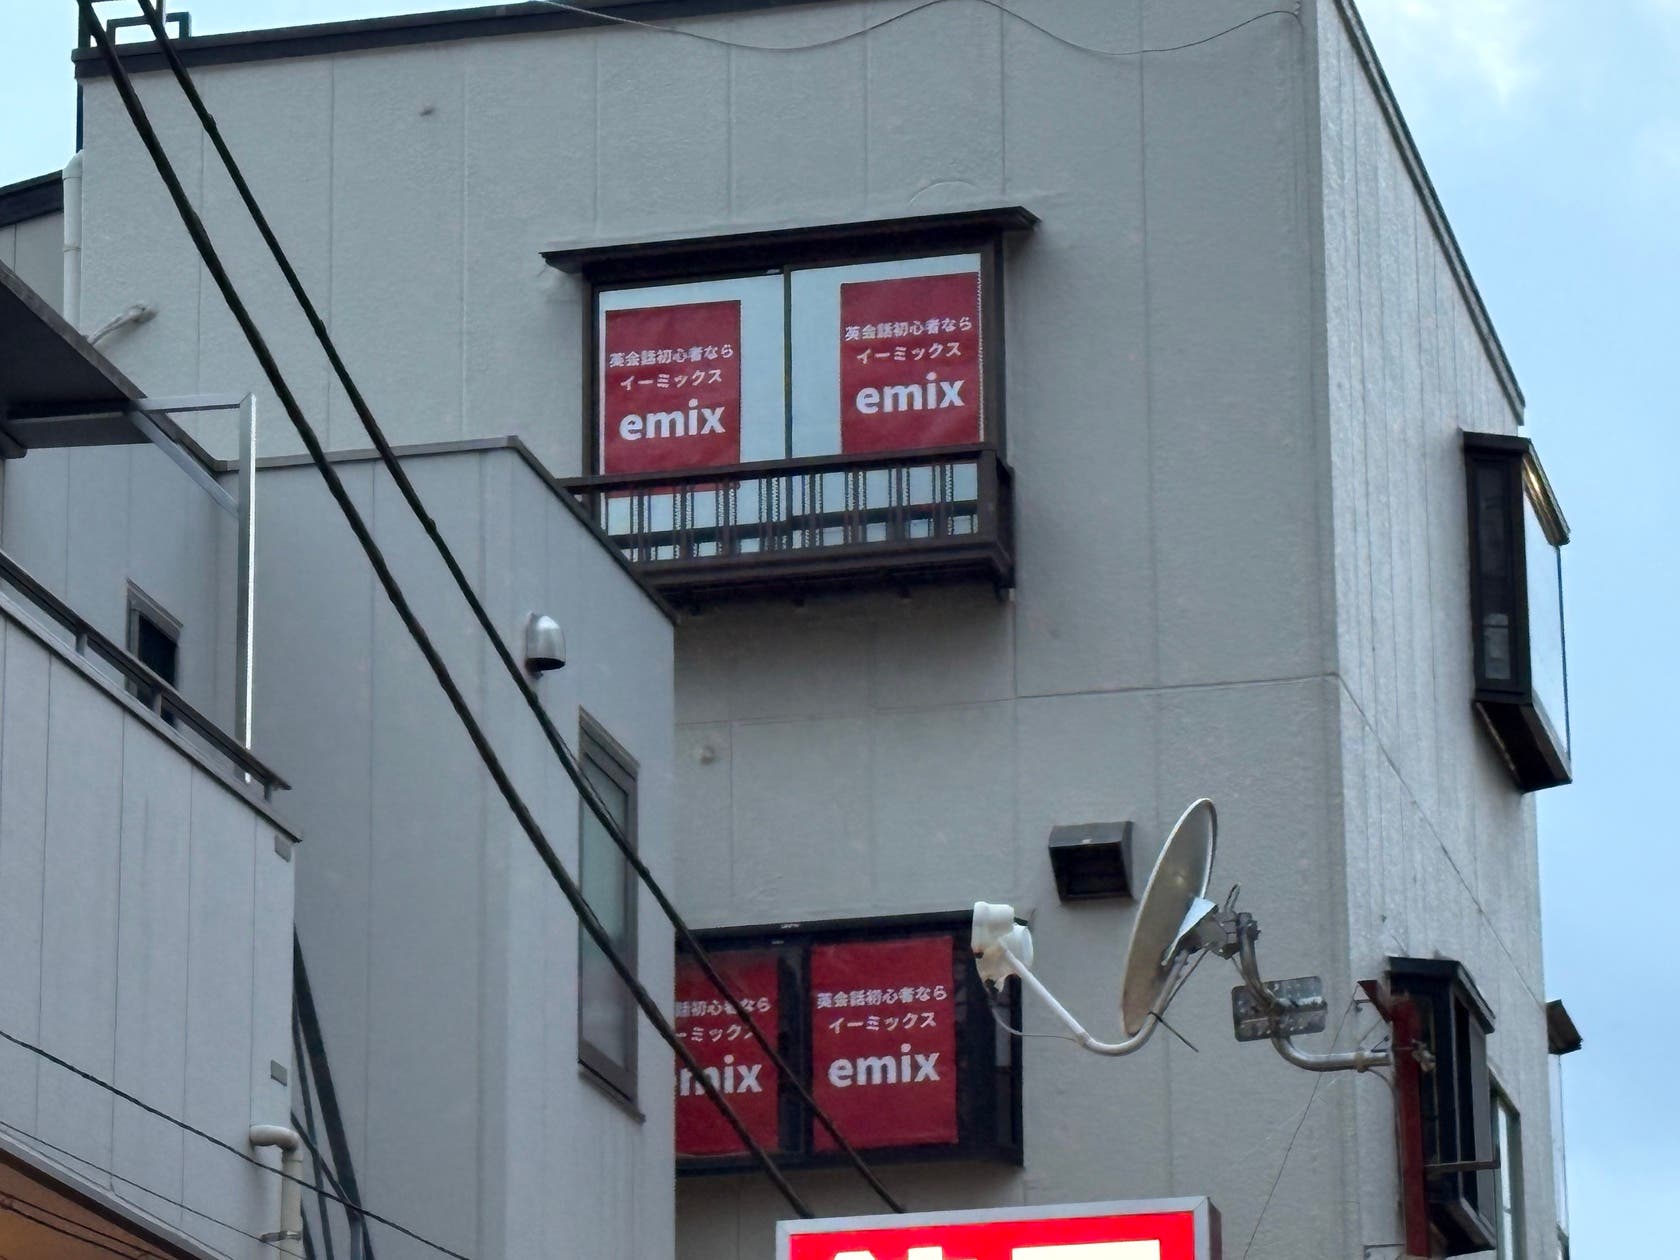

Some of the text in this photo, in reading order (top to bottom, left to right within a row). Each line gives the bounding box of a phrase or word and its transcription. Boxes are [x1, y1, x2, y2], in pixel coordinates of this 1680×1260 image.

[845, 316, 972, 341] 英会話初心者なら
[609, 344, 734, 368] 英会話初心者なら
[856, 342, 962, 364] イーミックス
[620, 369, 722, 391] イーミックス
[856, 371, 966, 414] emix
[619, 398, 726, 441] emix
[817, 985, 948, 1009] 英会話初心者なら
[828, 1012, 937, 1034] イーミックス
[679, 1054, 763, 1097] mix
[828, 1043, 941, 1088] emix
